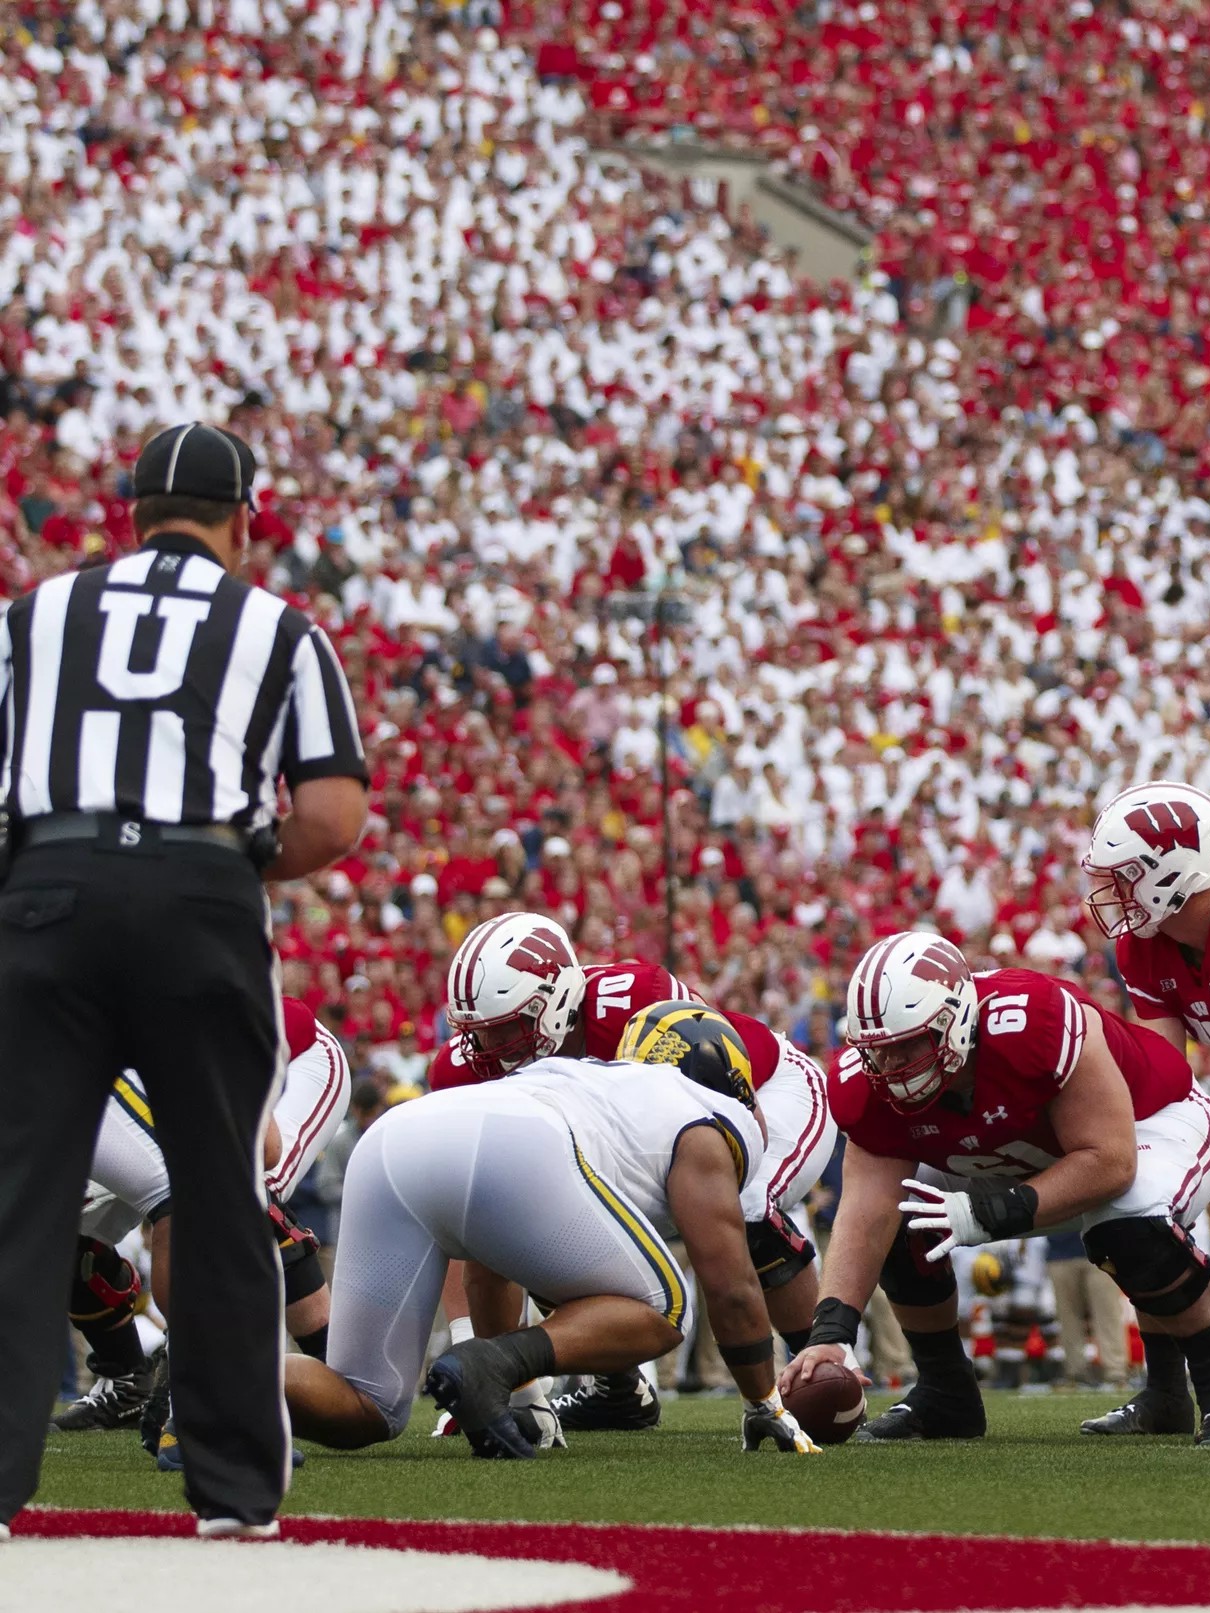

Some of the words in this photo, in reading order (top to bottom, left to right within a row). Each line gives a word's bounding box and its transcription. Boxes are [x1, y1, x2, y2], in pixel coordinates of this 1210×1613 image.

[97, 590, 211, 699] U
[120, 821, 141, 847] S
[1124, 801, 1201, 857] W
[506, 927, 574, 984] W
[911, 941, 973, 996] W
[596, 973, 636, 1020] 70
[987, 993, 1030, 1036] 61
[860, 1030, 887, 1040] Riddell
